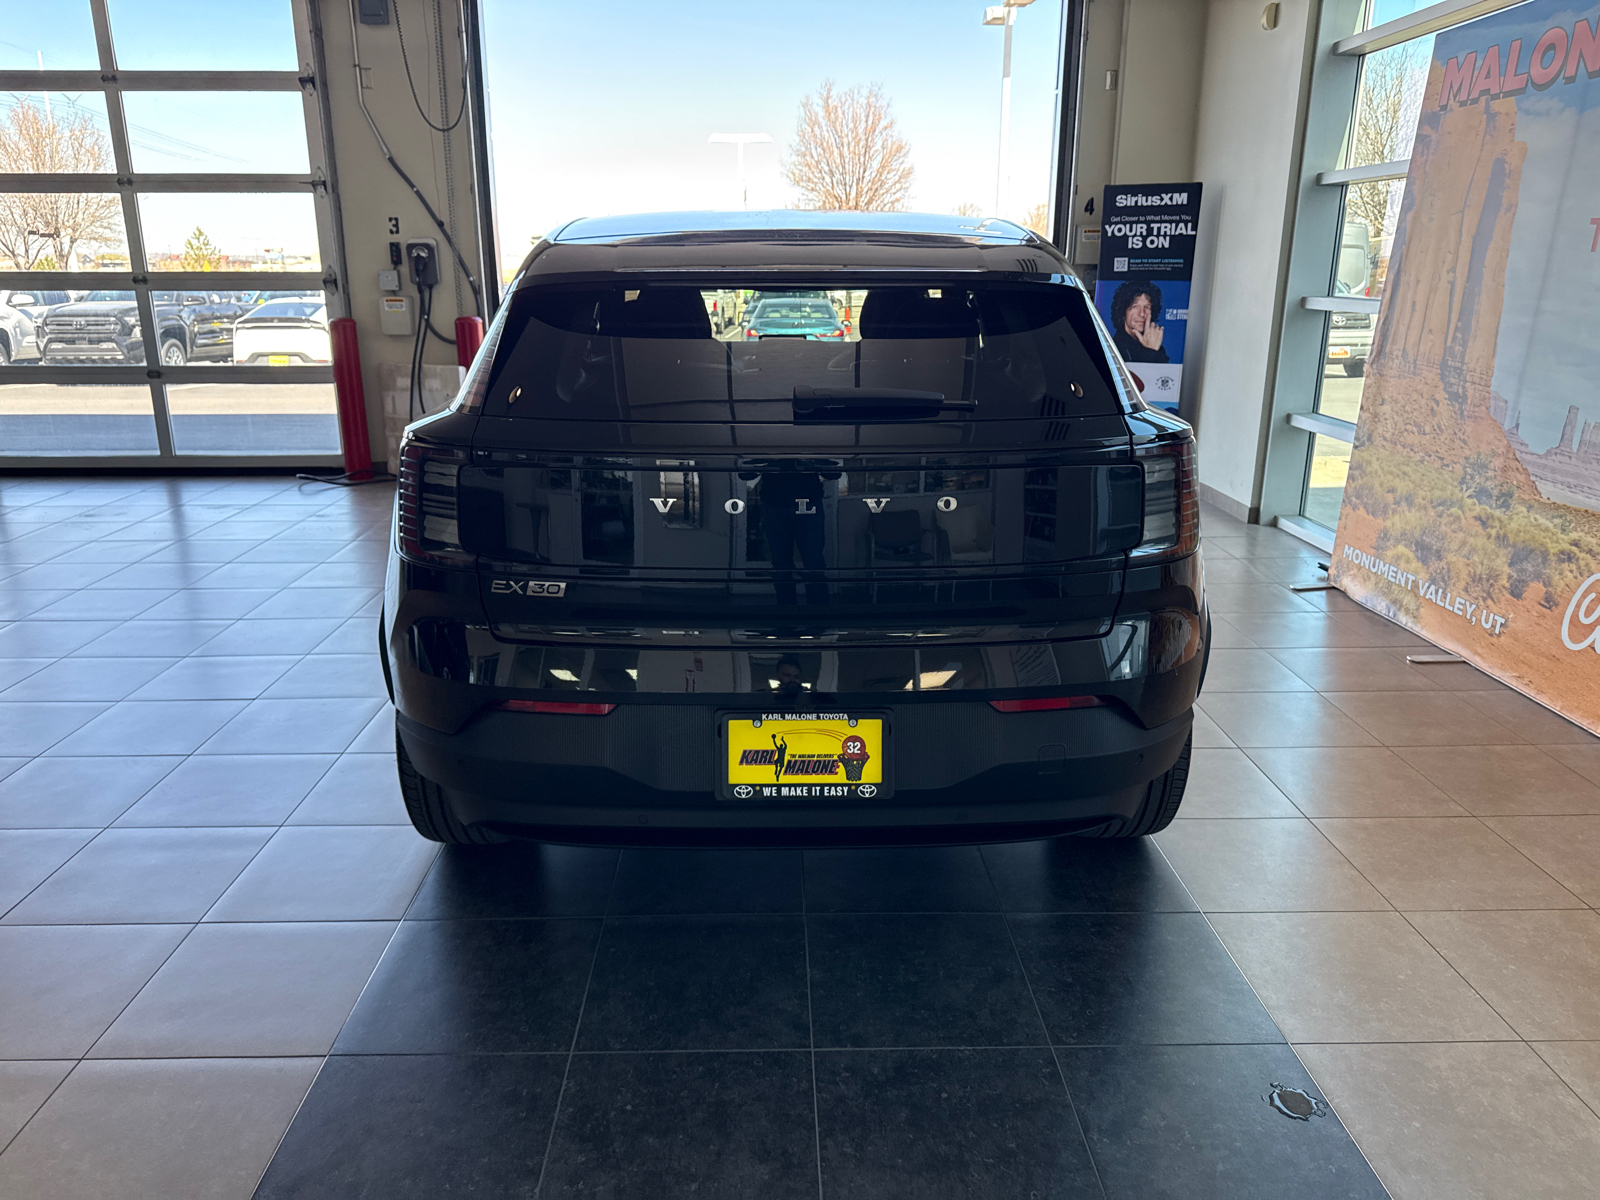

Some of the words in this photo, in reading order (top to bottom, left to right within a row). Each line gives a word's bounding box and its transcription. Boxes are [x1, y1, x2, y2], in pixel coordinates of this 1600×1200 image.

[1084, 196, 1095, 216] 4
[1115, 192, 1188, 207] SiriusXM
[388, 217, 400, 235] 3
[1104, 223, 1147, 237] YOUR
[1150, 222, 1196, 236] TRIAL
[1127, 236, 1143, 249] IS
[1145, 236, 1170, 249] ON
[1343, 544, 1416, 591] MONUMENT
[1418, 579, 1477, 626] VALLEY,
[1480, 609, 1506, 635] UT
[761, 713, 783, 721] KARL
[784, 713, 817, 721] MALONE
[846, 741, 861, 754] 32
[739, 749, 776, 766] KARL
[783, 759, 841, 776] MALONE
[763, 786, 780, 797] WE
[781, 786, 808, 797] MAKE
[812, 786, 821, 797] IT
[823, 786, 849, 797] EASY
